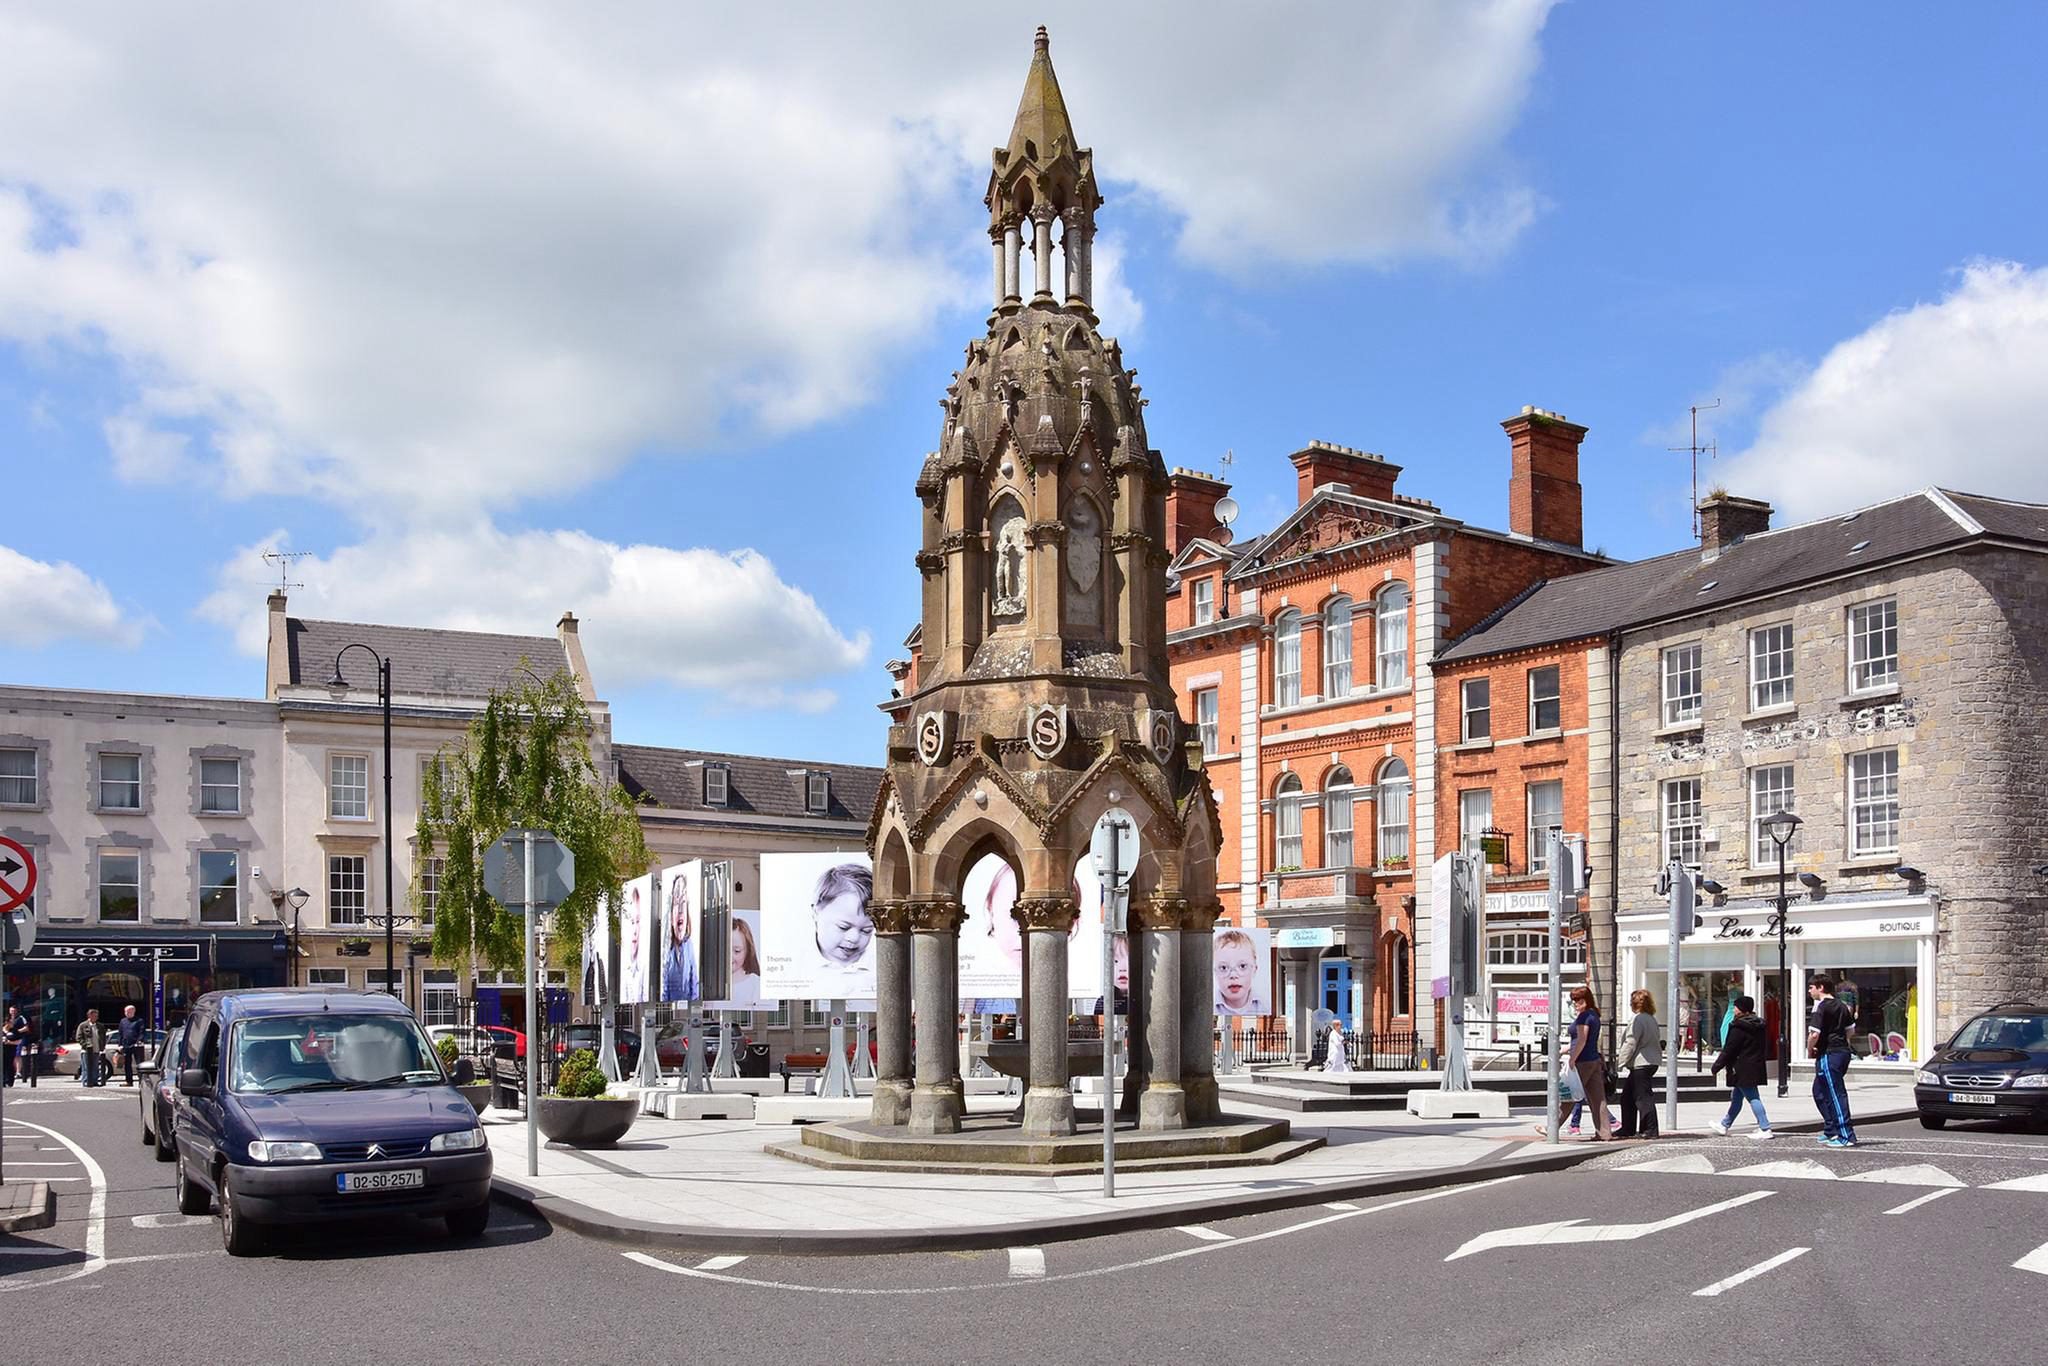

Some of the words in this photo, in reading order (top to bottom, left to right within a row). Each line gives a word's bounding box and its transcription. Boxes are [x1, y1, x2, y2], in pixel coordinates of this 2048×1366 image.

[923, 723, 940, 752] S
[1036, 717, 1058, 746] S
[1511, 894, 1550, 909] BOUTI
[1713, 916, 1754, 938] Lou
[1760, 914, 1803, 936] Lou
[1879, 921, 1921, 932] BOUTIQUE
[53, 946, 174, 957] BOYLE
[766, 965, 778, 973] age
